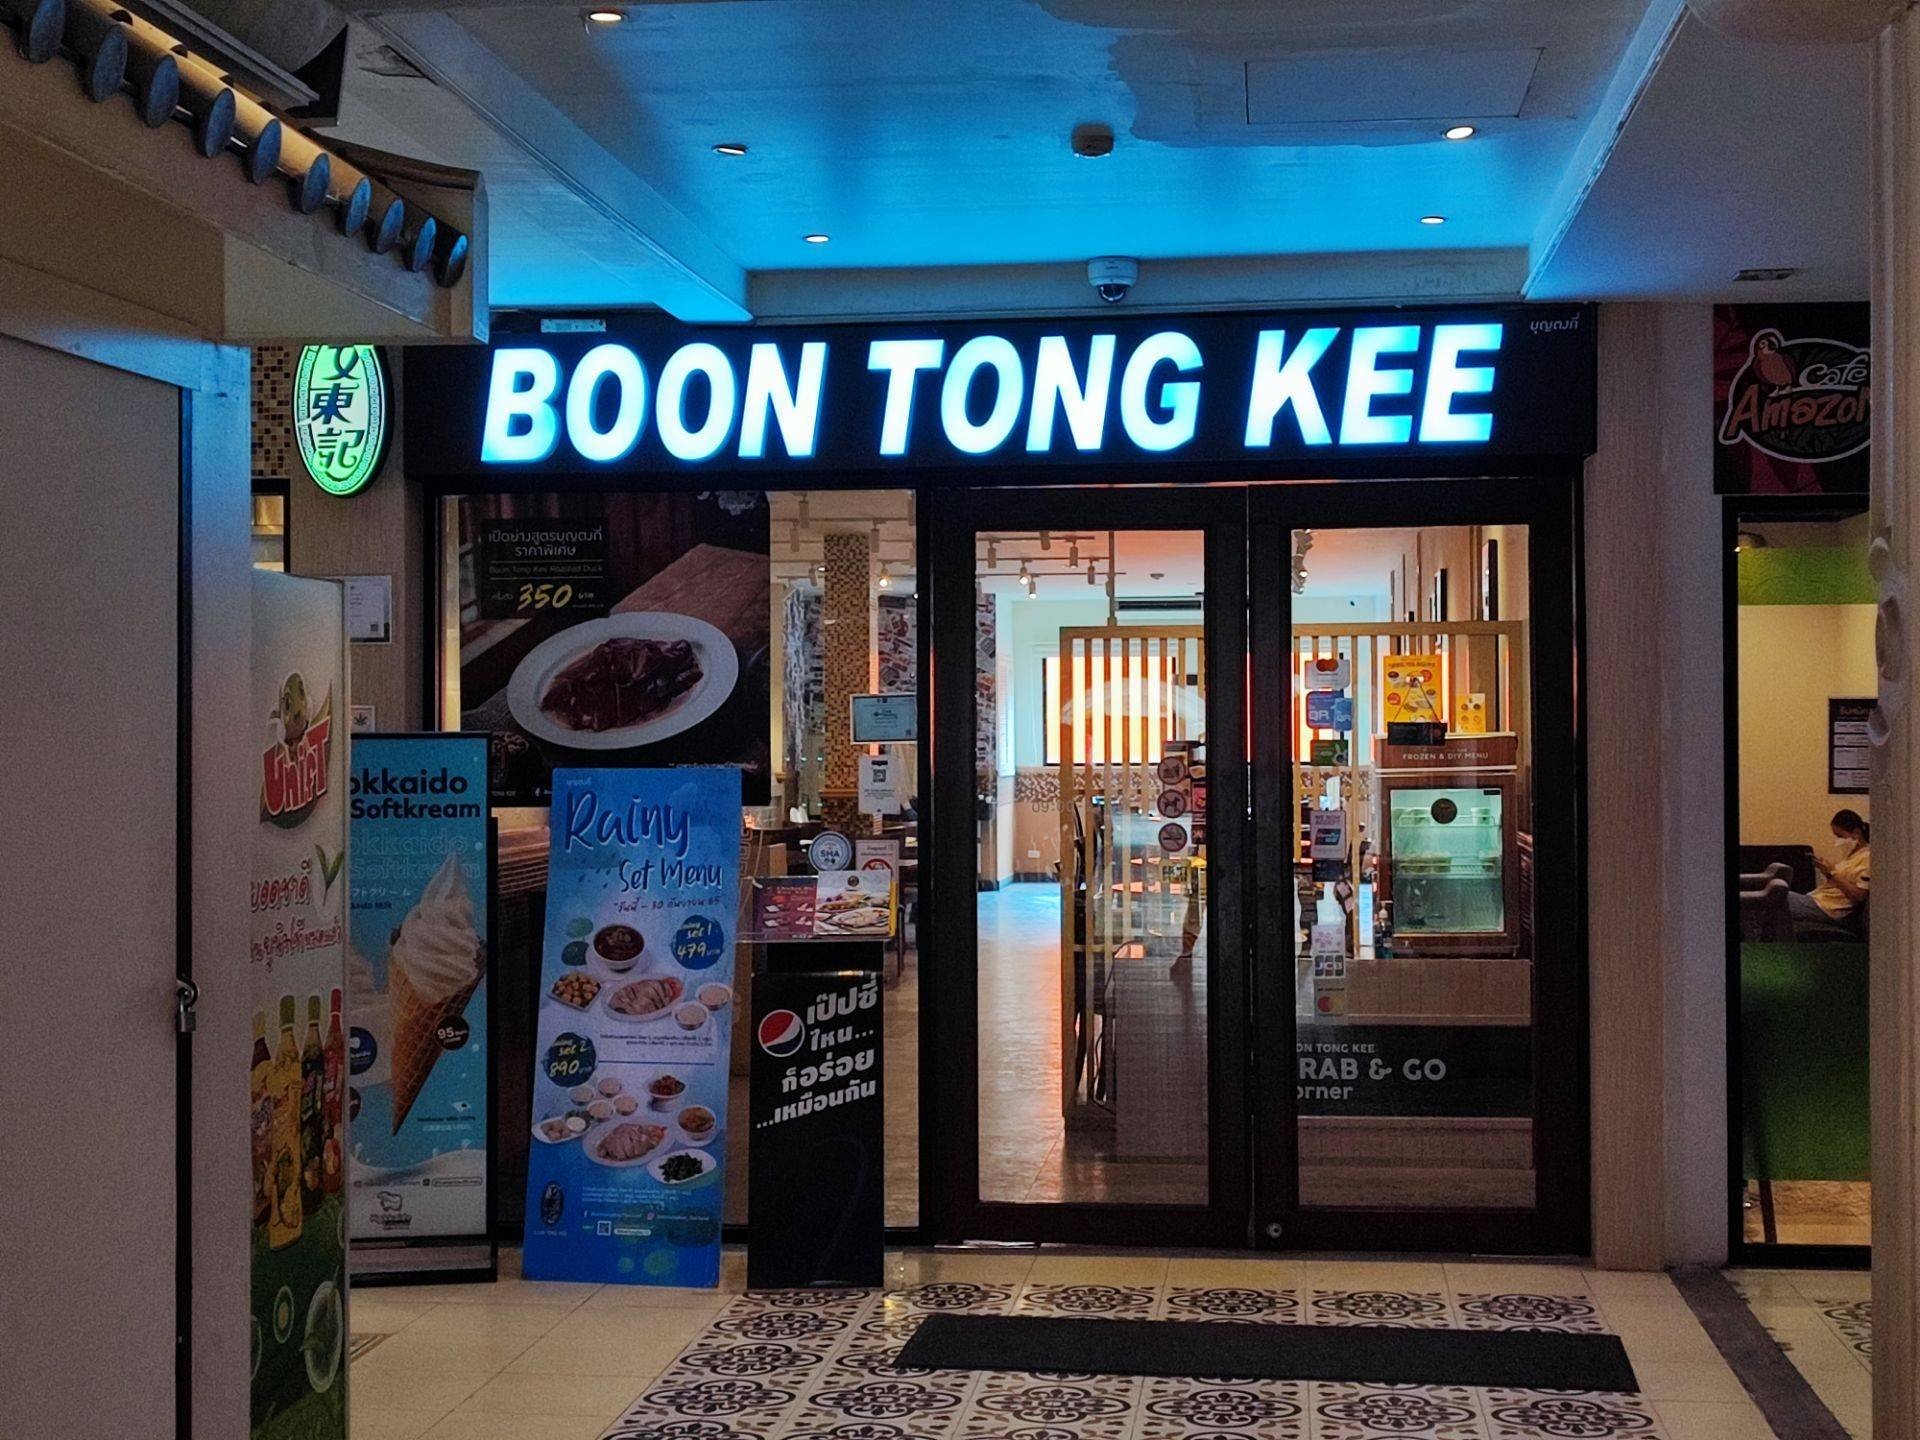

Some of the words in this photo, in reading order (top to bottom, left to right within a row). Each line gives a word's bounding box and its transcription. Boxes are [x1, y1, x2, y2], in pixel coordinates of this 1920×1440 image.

[481, 342, 828, 462] BOON
[868, 331, 1204, 455] TONG
[1244, 323, 1503, 447] KEE
[517, 583, 574, 610] 350
[1403, 752, 1436, 761] FROZEN
[1448, 752, 1462, 760] DIY
[1464, 751, 1489, 760] MENU
[350, 797, 481, 819] Softkream
[565, 790, 691, 860] Rainy
[820, 850, 839, 858] SHA
[618, 858, 656, 893] Set
[660, 856, 724, 892] Menu
[676, 941, 707, 960] 479
[806, 971, 879, 1025] เป๊ปซี่
[437, 1027, 454, 1039] 95
[1316, 1043, 1349, 1053] TONG
[1352, 1043, 1377, 1054] KEE
[549, 1059, 580, 1078] 890
[782, 1048, 876, 1094] ก็อร่อย
[1299, 1057, 1359, 1080] RAB
[1368, 1057, 1393, 1080] &
[1402, 1058, 1447, 1080] GO
